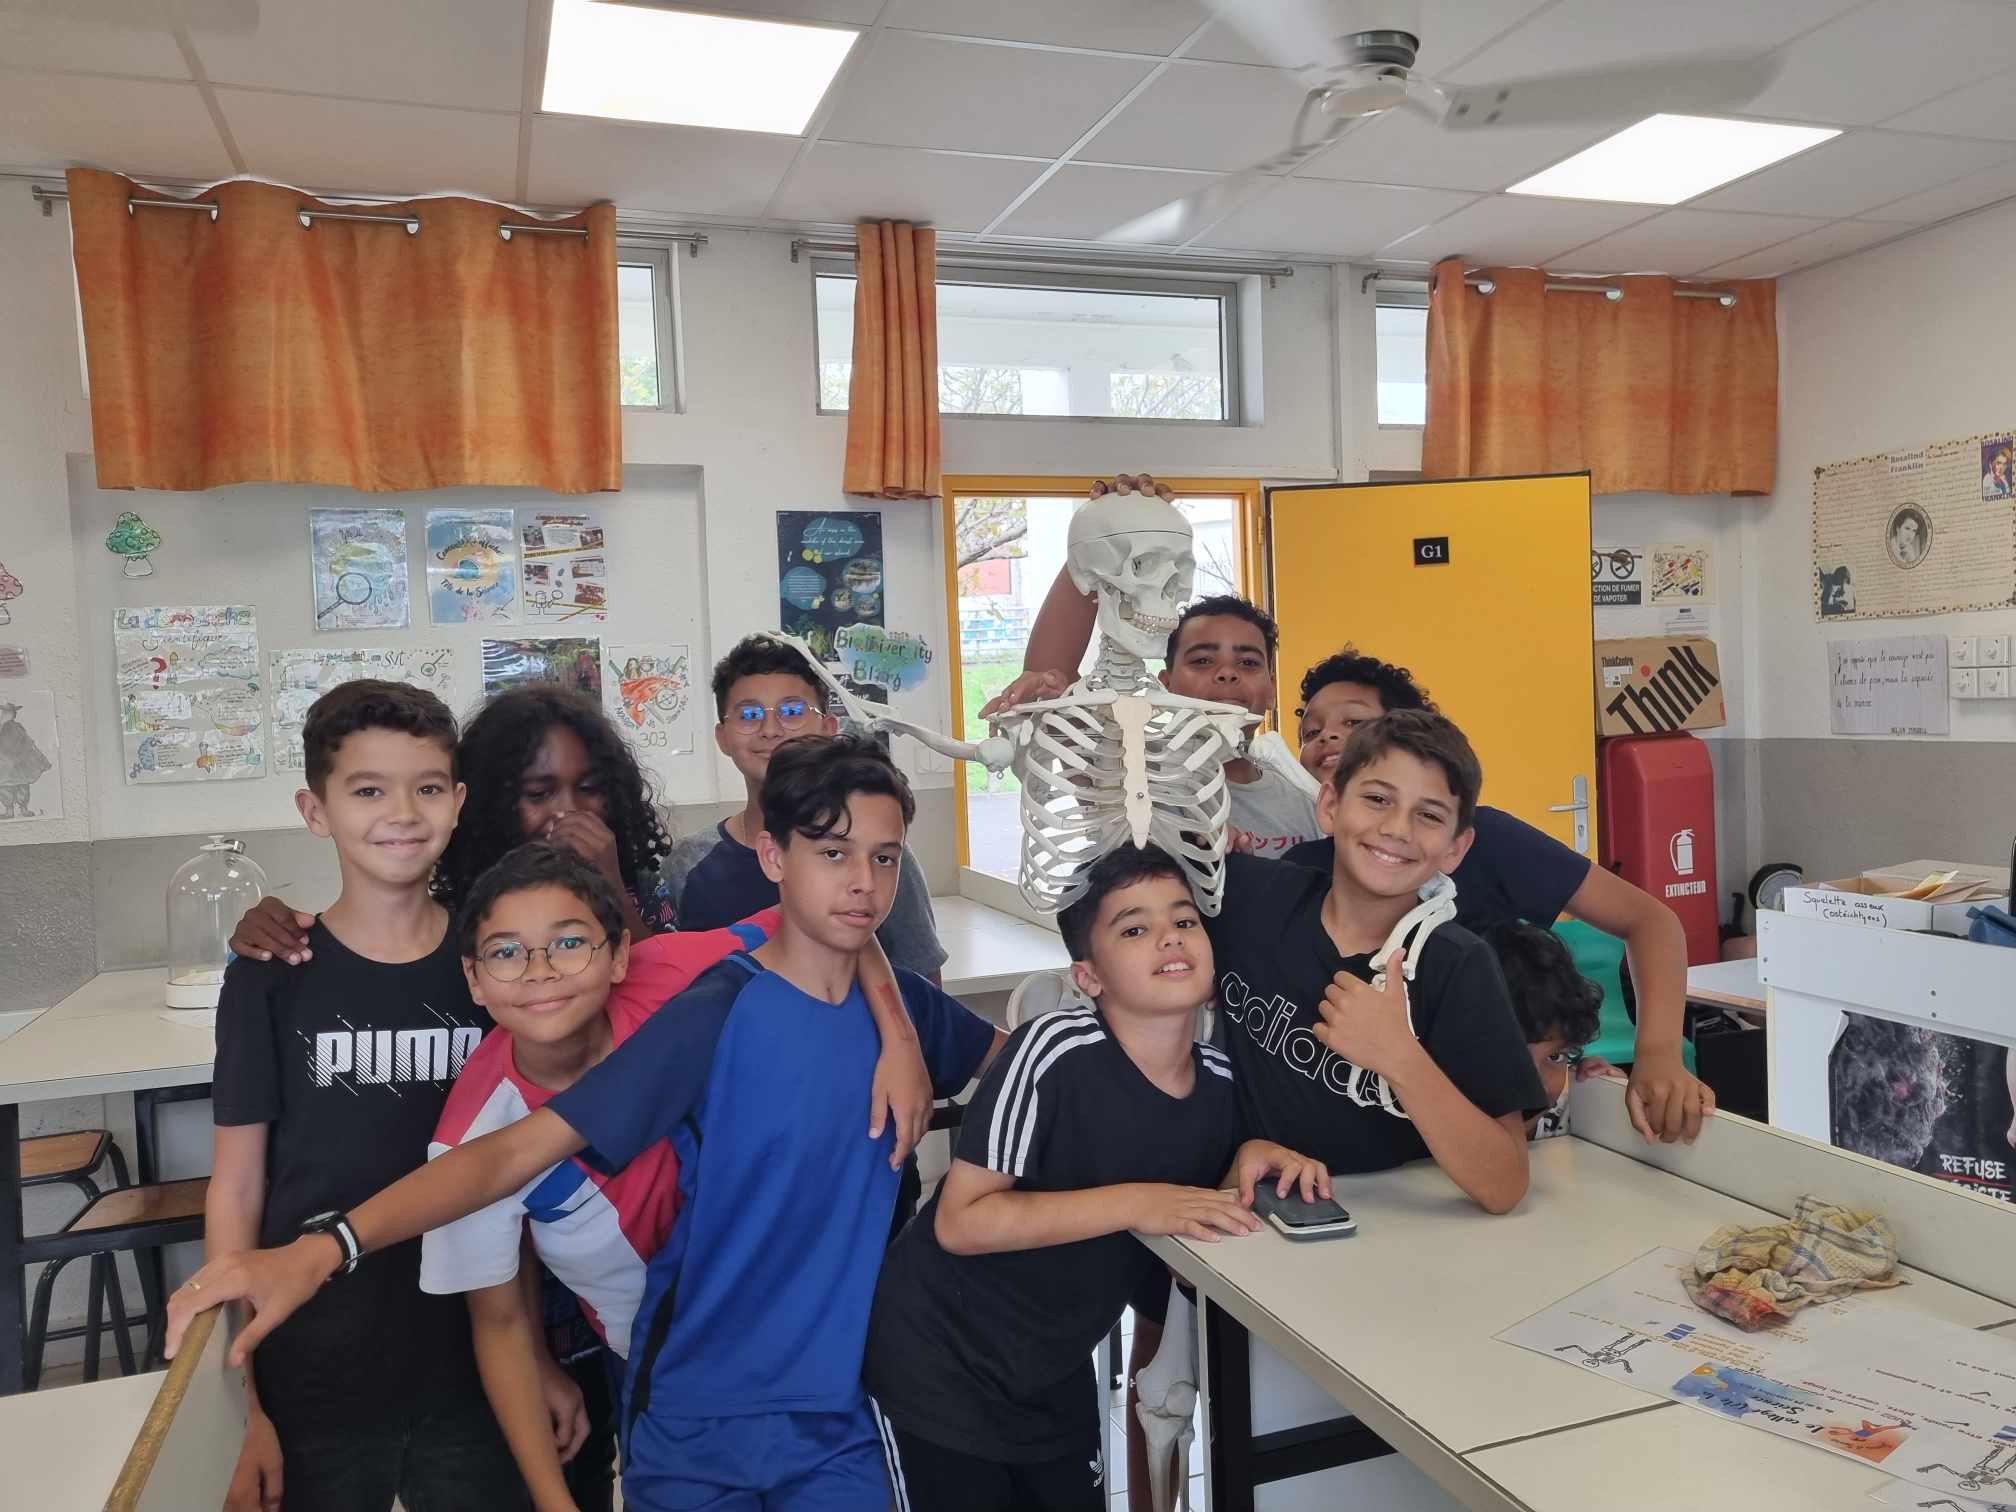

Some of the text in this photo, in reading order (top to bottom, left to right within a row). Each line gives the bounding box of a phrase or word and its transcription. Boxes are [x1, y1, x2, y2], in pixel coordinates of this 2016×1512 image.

[1889, 451, 1925, 464] Rosalind
[1889, 461, 1925, 474] Franklin
[1420, 544, 1443, 559] G1
[1620, 582, 1641, 592] FUMER
[1601, 593, 1628, 602] VAPOTER
[1606, 645, 1719, 734] Think
[1665, 880, 1706, 899] EXTINCTEUR
[1803, 891, 1847, 912] Squelette
[1939, 1153, 2007, 1181] REFUSE
[1750, 1394, 1805, 1415] Science
